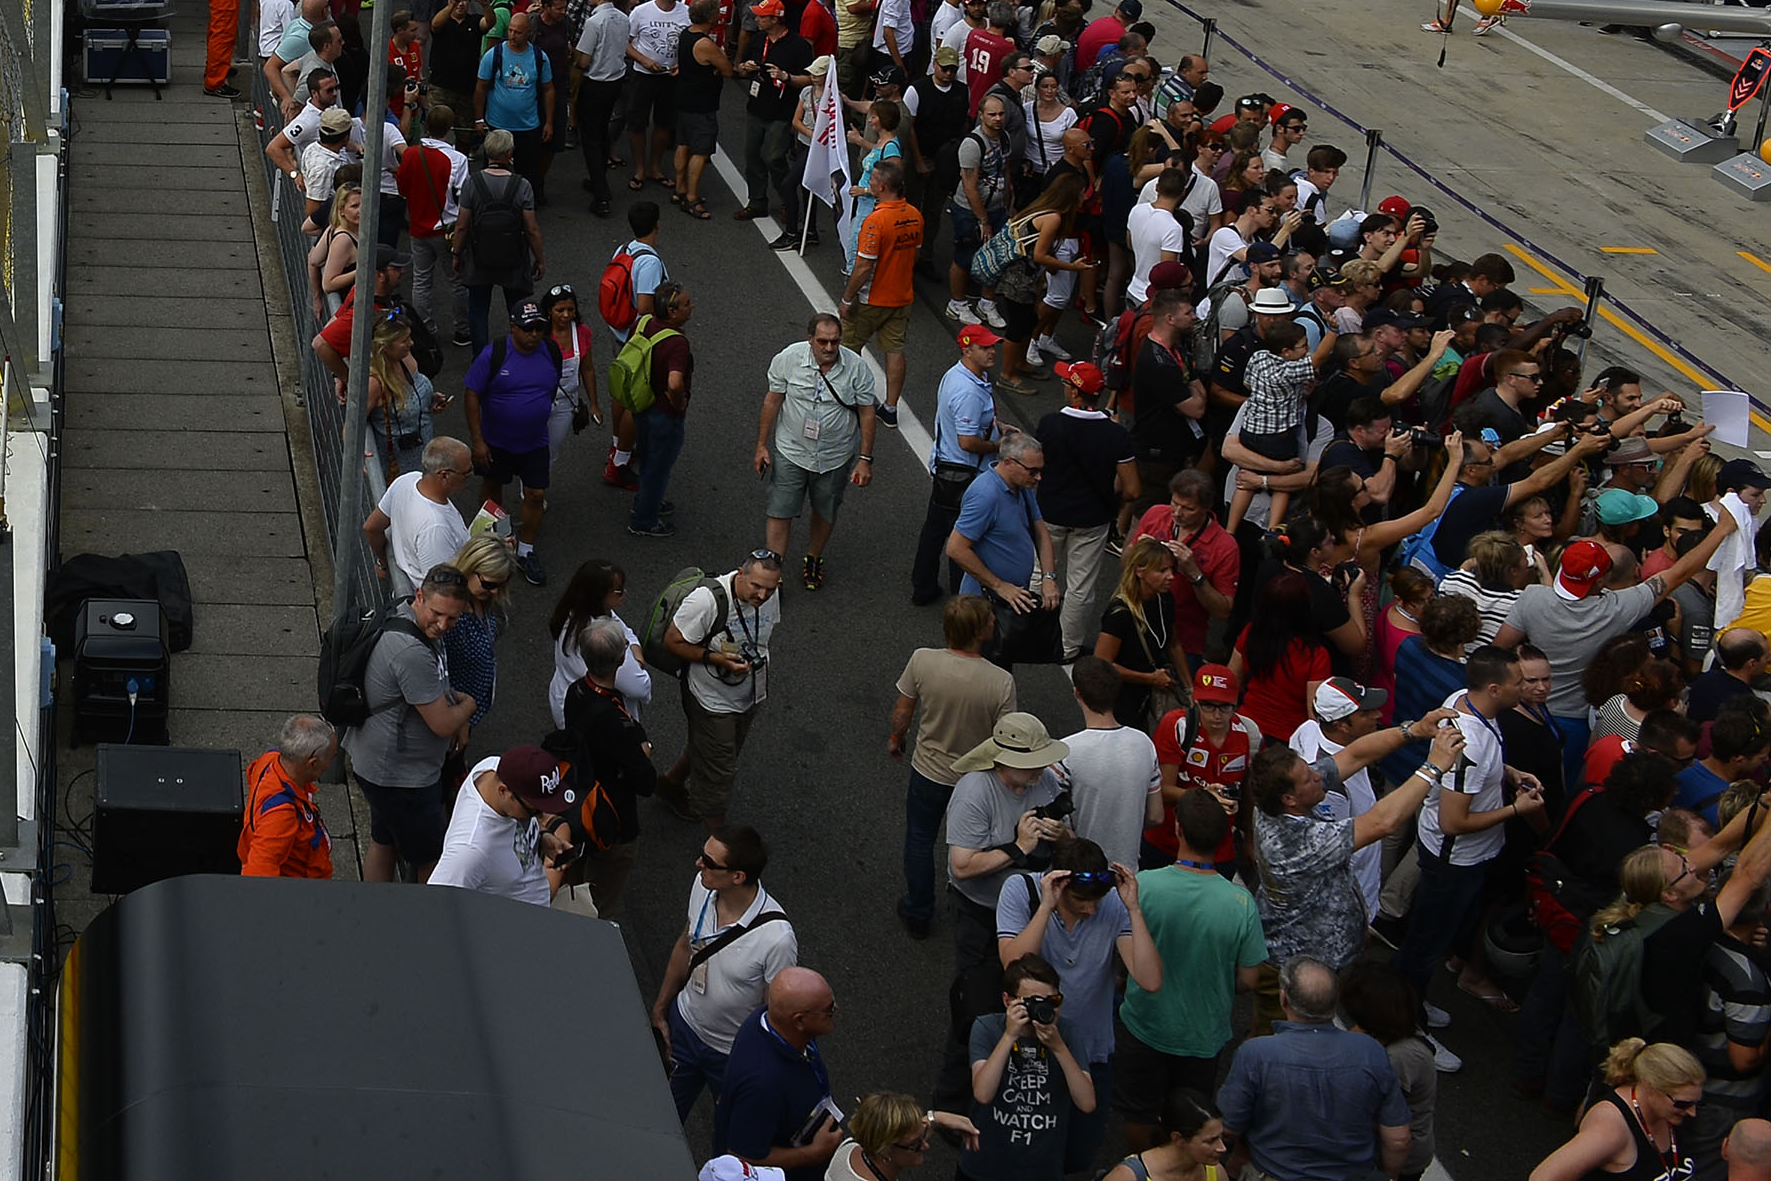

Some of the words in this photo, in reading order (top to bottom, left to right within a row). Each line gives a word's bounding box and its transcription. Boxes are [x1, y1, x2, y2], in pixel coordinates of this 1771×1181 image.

[970, 48, 990, 74] 19
[290, 125, 303, 137] 3
[1008, 1074, 1046, 1089] KEEP
[1003, 1089, 1050, 1105] CALM
[993, 1106, 1057, 1129] WATCH
[1010, 1130, 1032, 1145] F1
